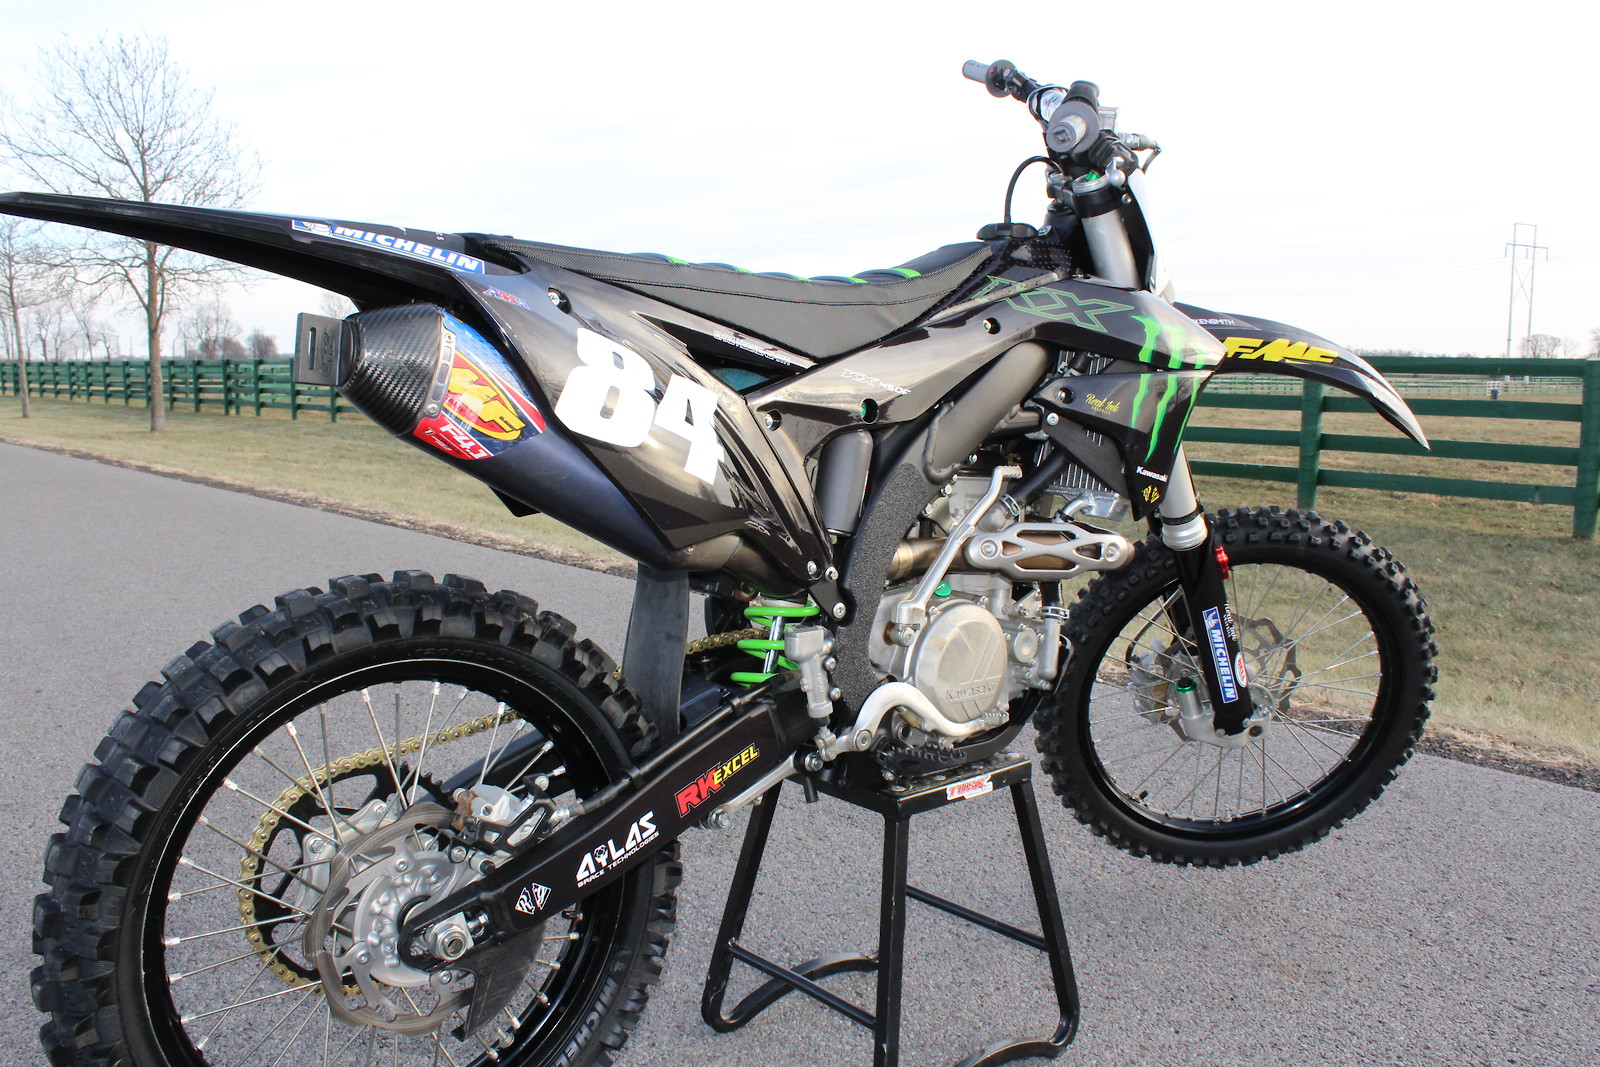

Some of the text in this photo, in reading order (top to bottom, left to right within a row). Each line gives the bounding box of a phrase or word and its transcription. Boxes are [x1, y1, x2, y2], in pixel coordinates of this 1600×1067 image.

[334, 226, 478, 271] MICHELIN
[483, 285, 531, 311] AMA
[554, 327, 725, 485] 84
[1085, 393, 1121, 413] Real Ink
[1136, 465, 1168, 483] Kawasaki
[1211, 629, 1236, 700] MICHELIN
[945, 681, 994, 702] Kawasaki
[675, 743, 759, 817] RK EXCEL
[948, 776, 991, 797] TUSK
[577, 831, 659, 888] BRACE TECHNOLOGIES
